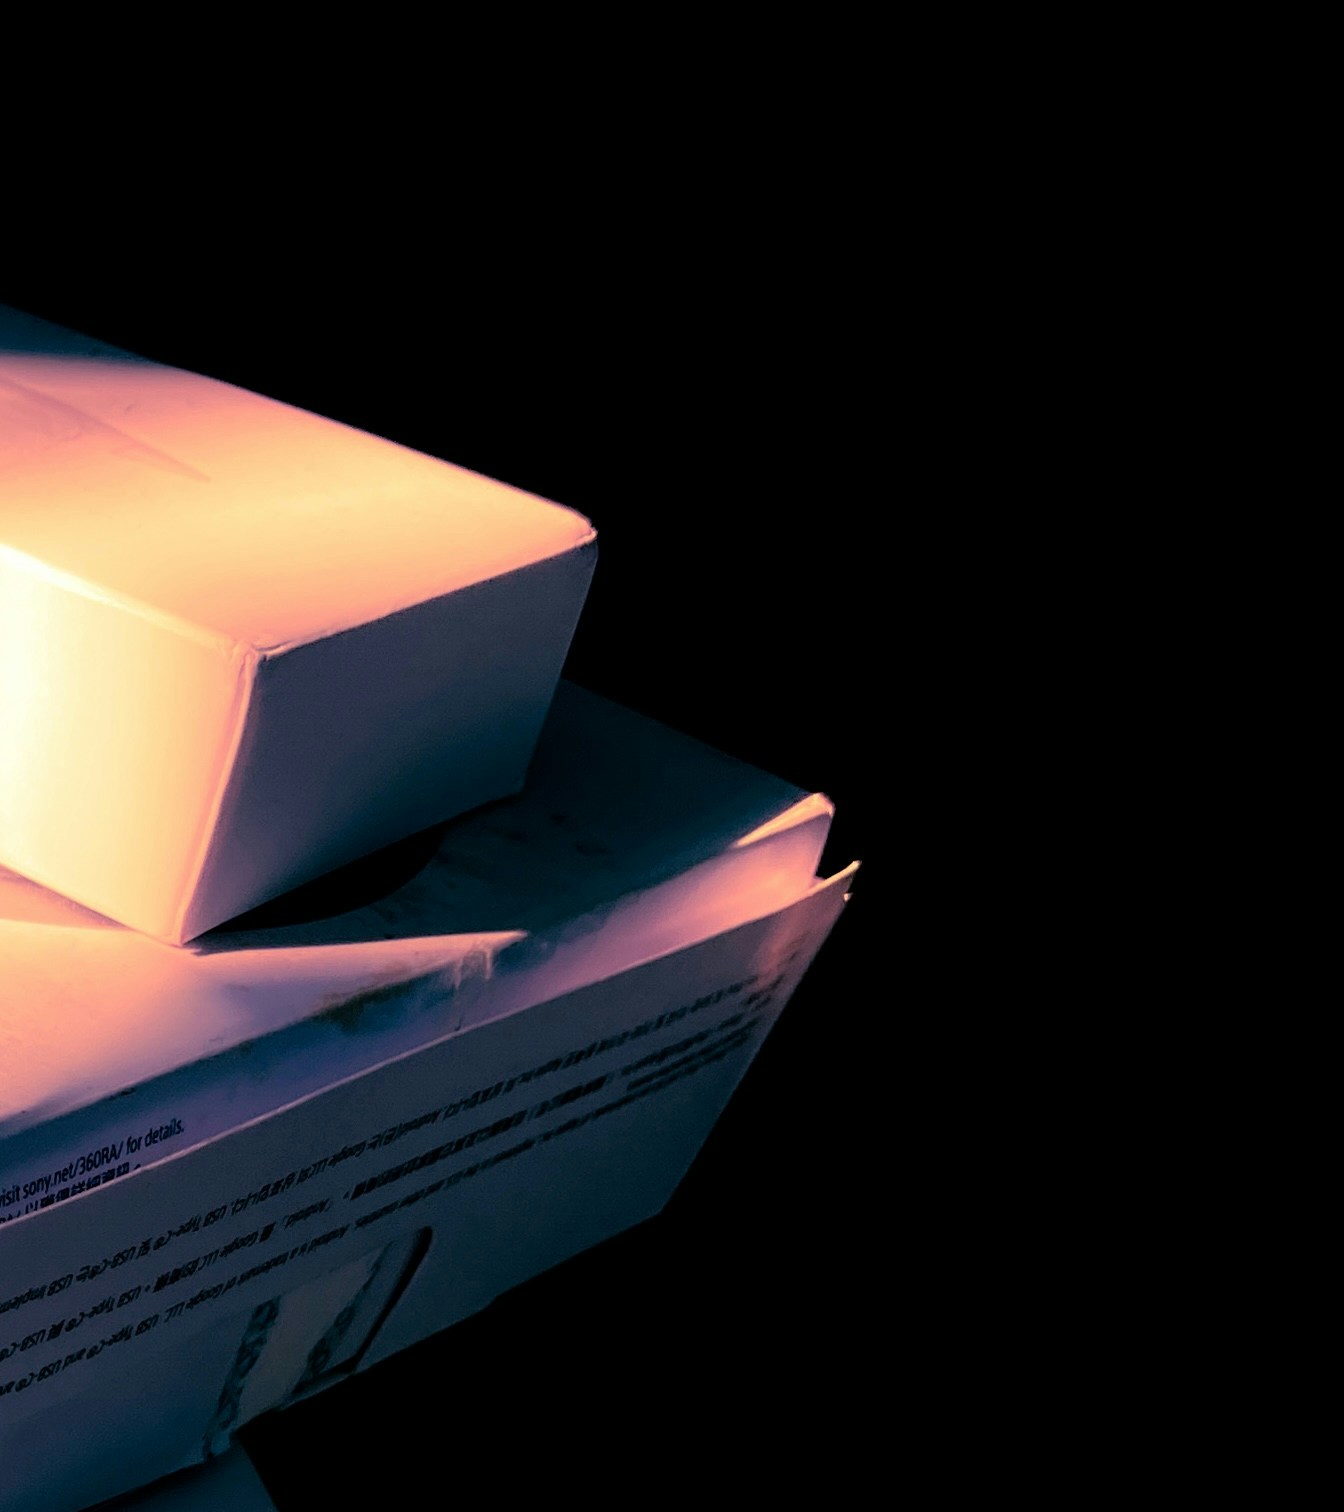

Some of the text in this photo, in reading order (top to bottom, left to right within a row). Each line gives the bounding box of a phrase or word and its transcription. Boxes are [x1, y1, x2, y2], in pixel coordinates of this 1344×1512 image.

[23, 1142, 124, 1199] sony.net/360RA/
[126, 1135, 143, 1155] for
[144, 1118, 185, 1147] details.
[47, 1273, 73, 1295] USB
[136, 1314, 159, 1334] USB
